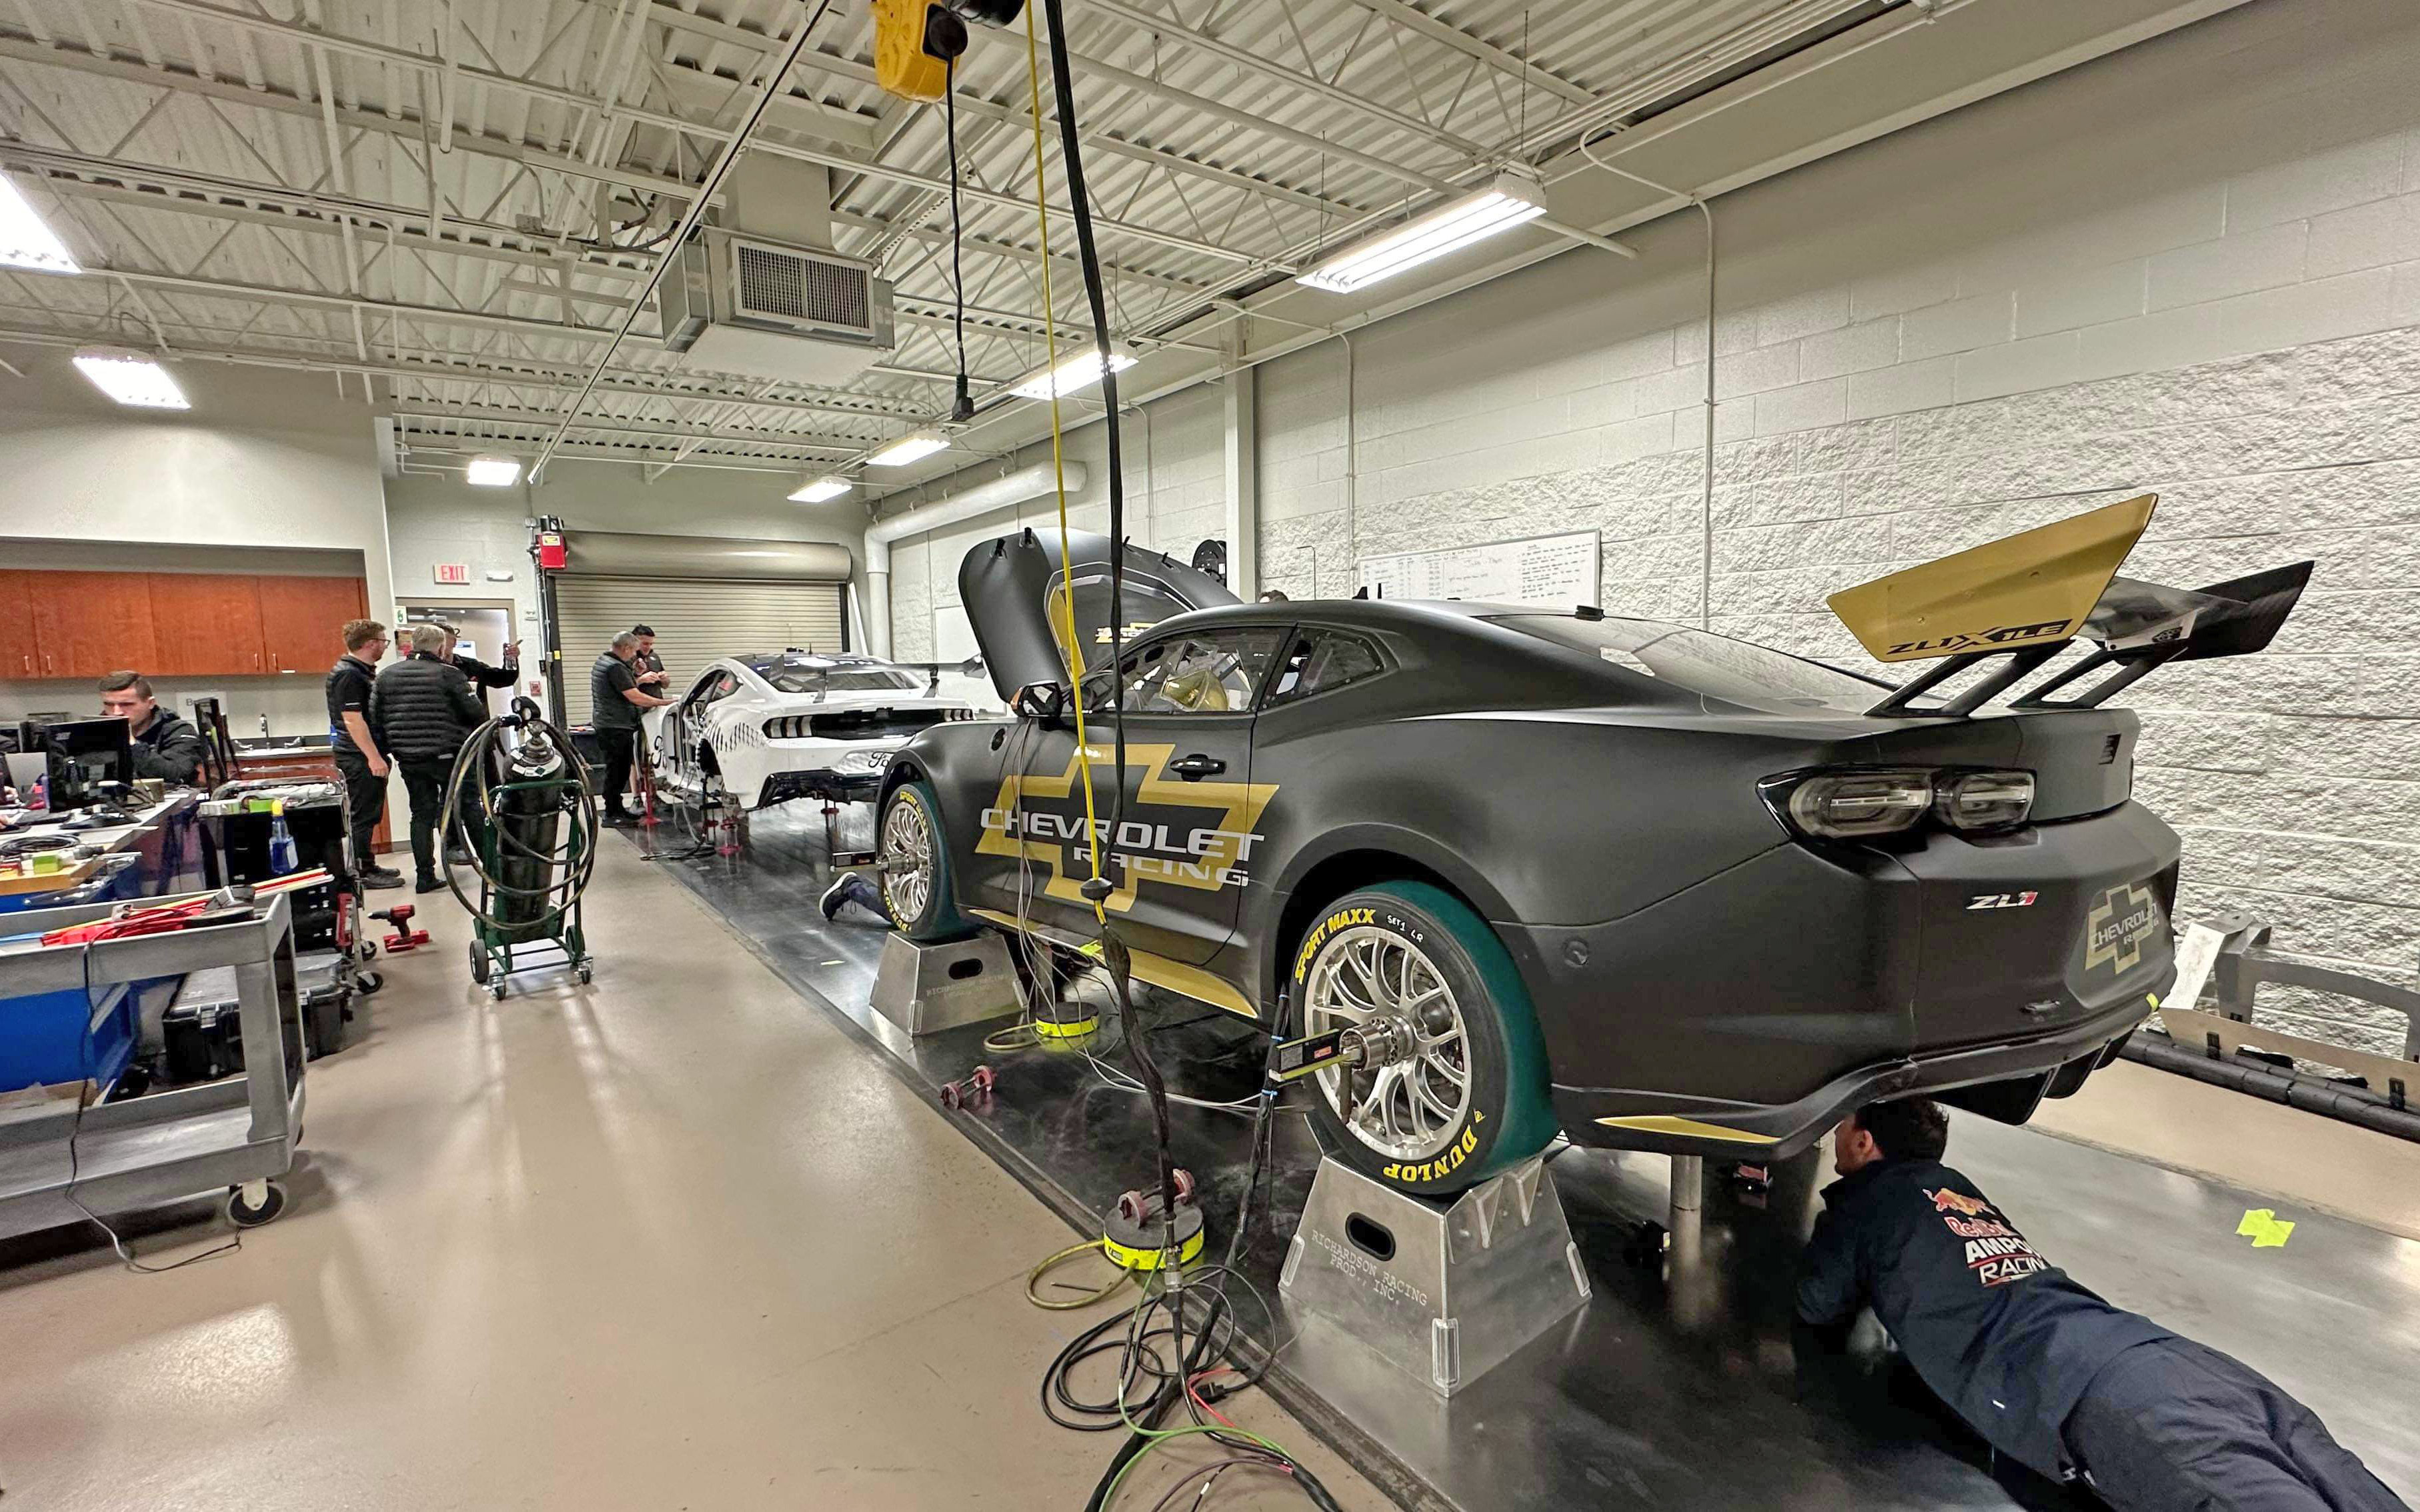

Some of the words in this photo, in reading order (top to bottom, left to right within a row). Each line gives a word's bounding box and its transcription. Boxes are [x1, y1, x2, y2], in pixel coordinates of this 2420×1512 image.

[440, 565, 465, 581] EXIT
[868, 751, 895, 768] Fo
[980, 807, 1265, 861] CHEVROLET
[1966, 891, 2038, 909] ZL1
[2090, 902, 2158, 950] CHEVROLT
[1294, 922, 1326, 986] SPORT
[1327, 907, 1376, 934] MAXX
[1382, 1124, 1478, 1183] DUNLOP
[1311, 1229, 1377, 1277] RICHARDSON
[1382, 1271, 1428, 1306] RACING
[1979, 1257, 2049, 1285] RACIN
[1373, 1279, 1400, 1305] INC.
